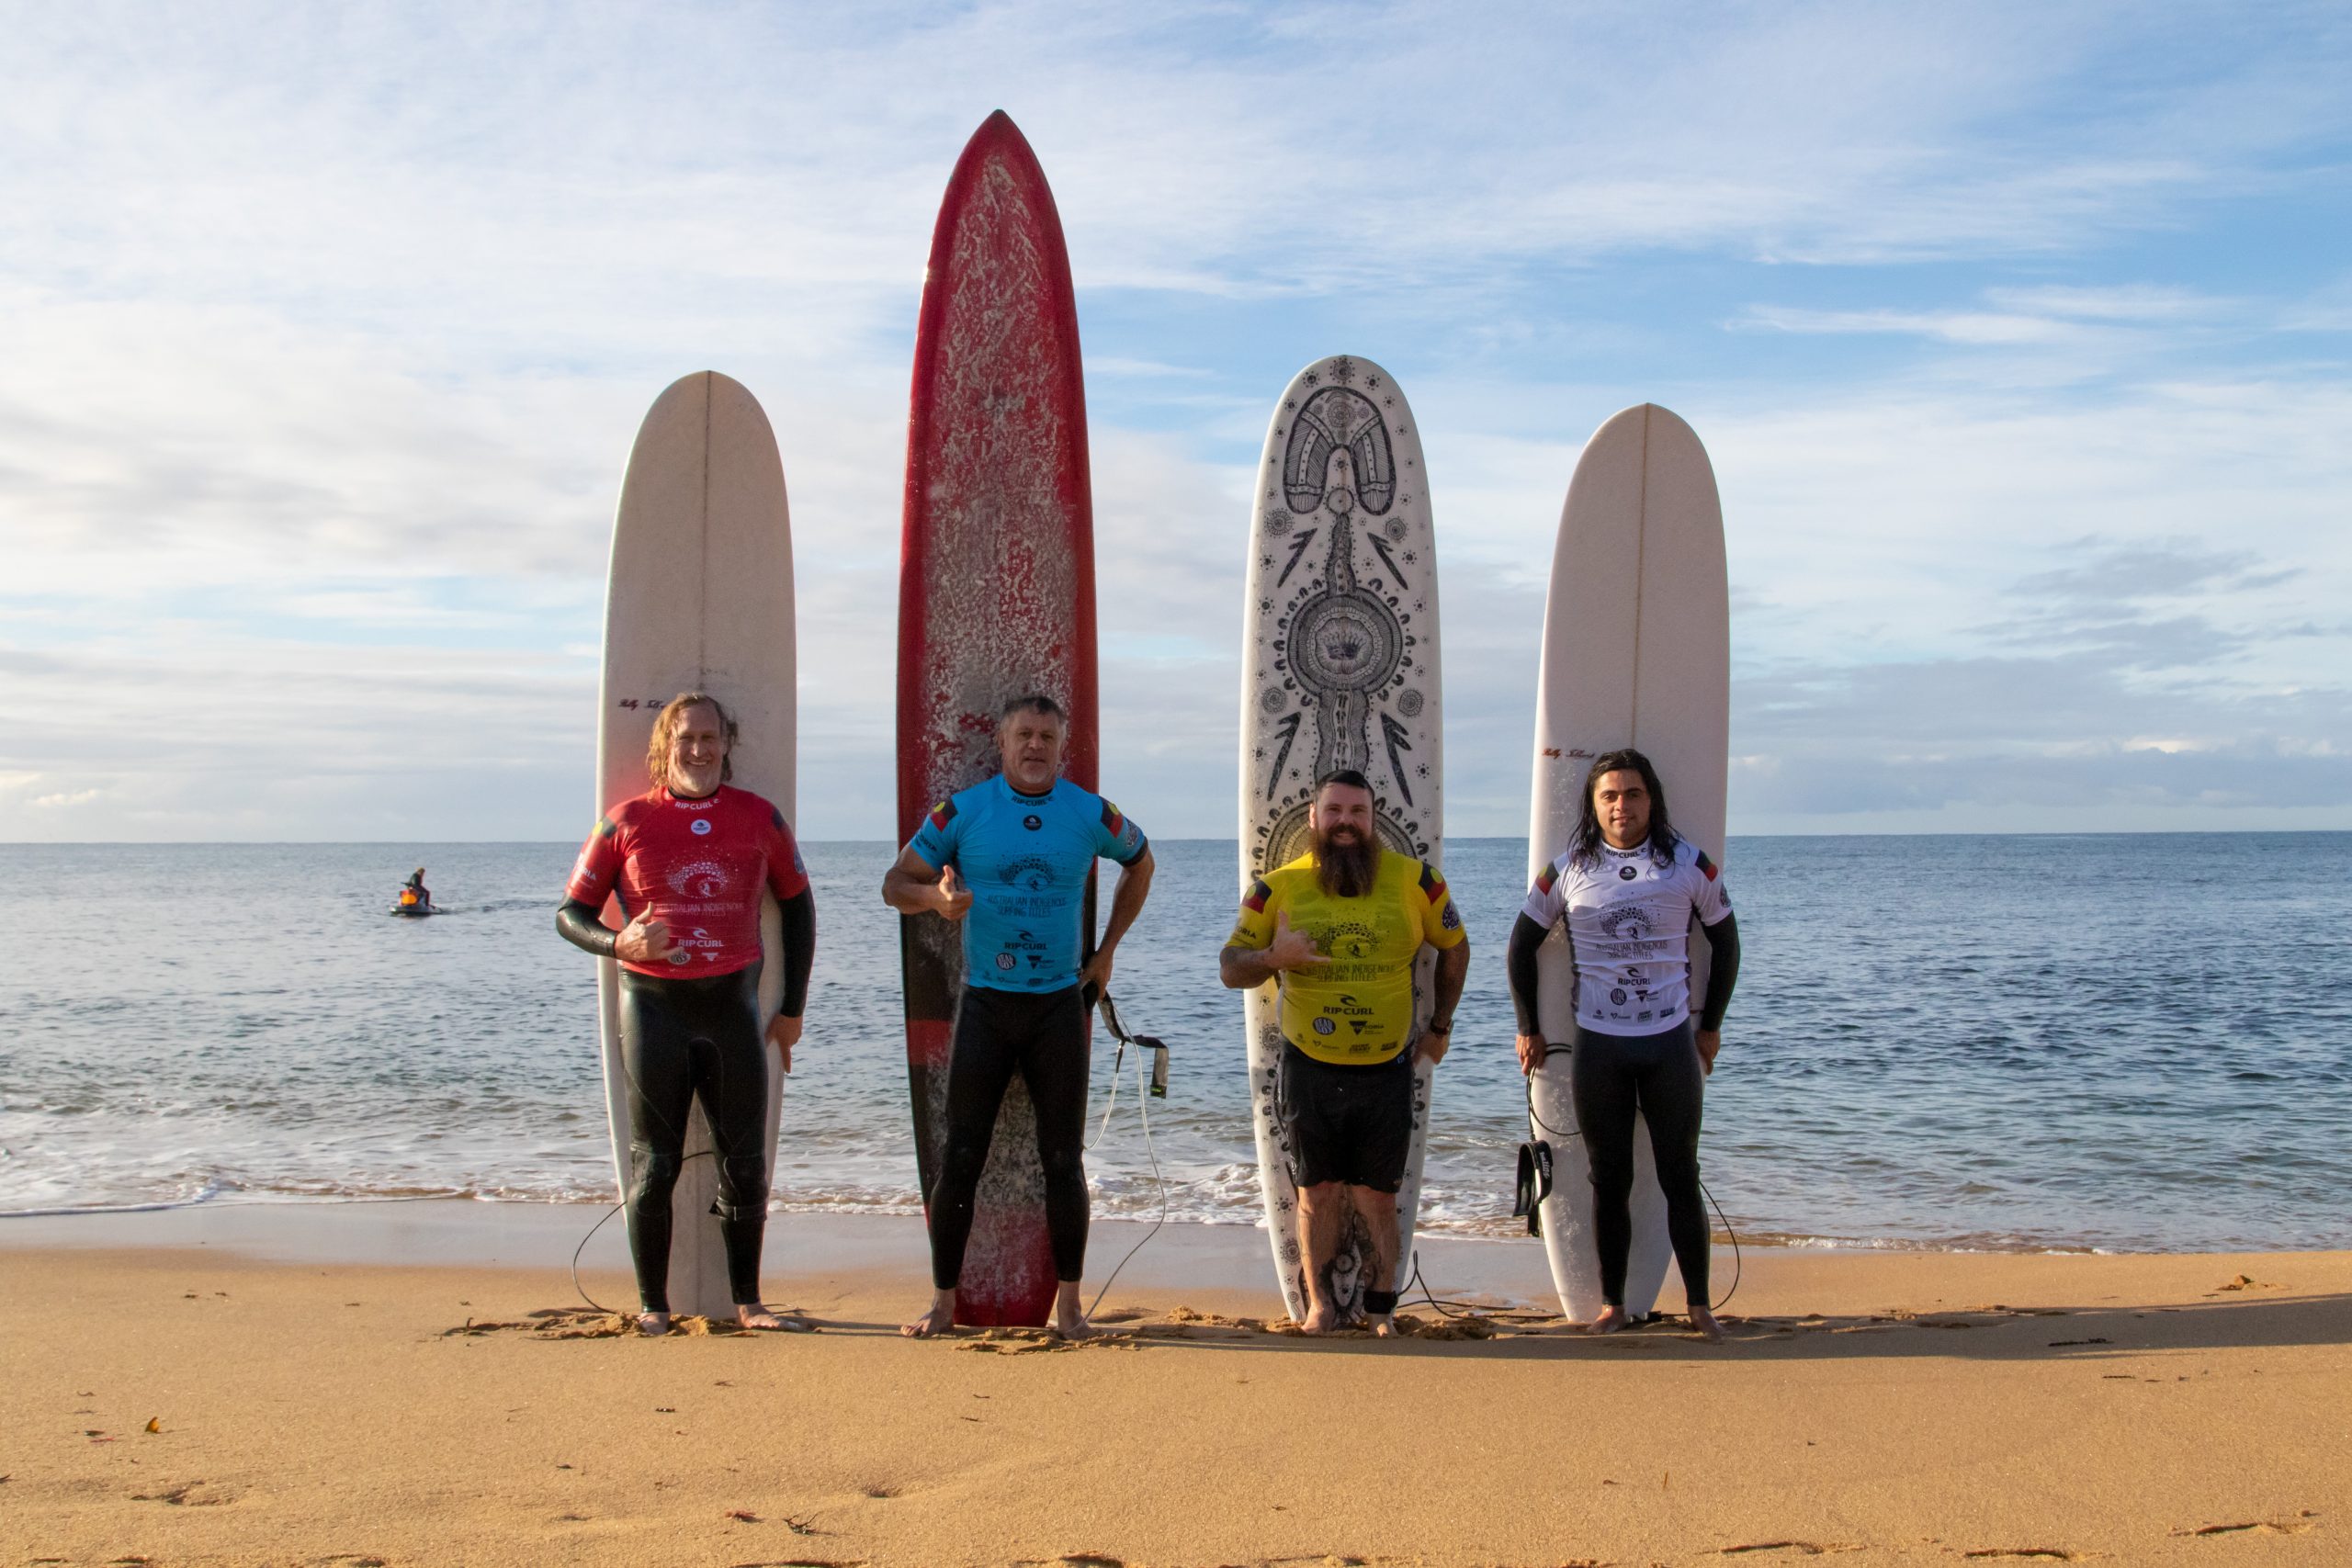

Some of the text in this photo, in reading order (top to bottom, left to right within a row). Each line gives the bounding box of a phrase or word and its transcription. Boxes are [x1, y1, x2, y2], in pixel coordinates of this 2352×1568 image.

[674, 800, 714, 810] RIP CURL
[1011, 795, 1047, 807] RIP CURL
[1605, 848, 1641, 859] RIP CURL
[678, 939, 725, 948] RIP CURL
[1004, 942, 1021, 950] RIP
[1617, 977, 1631, 986] RIP
[1323, 1006, 1375, 1015] RIP CURL
